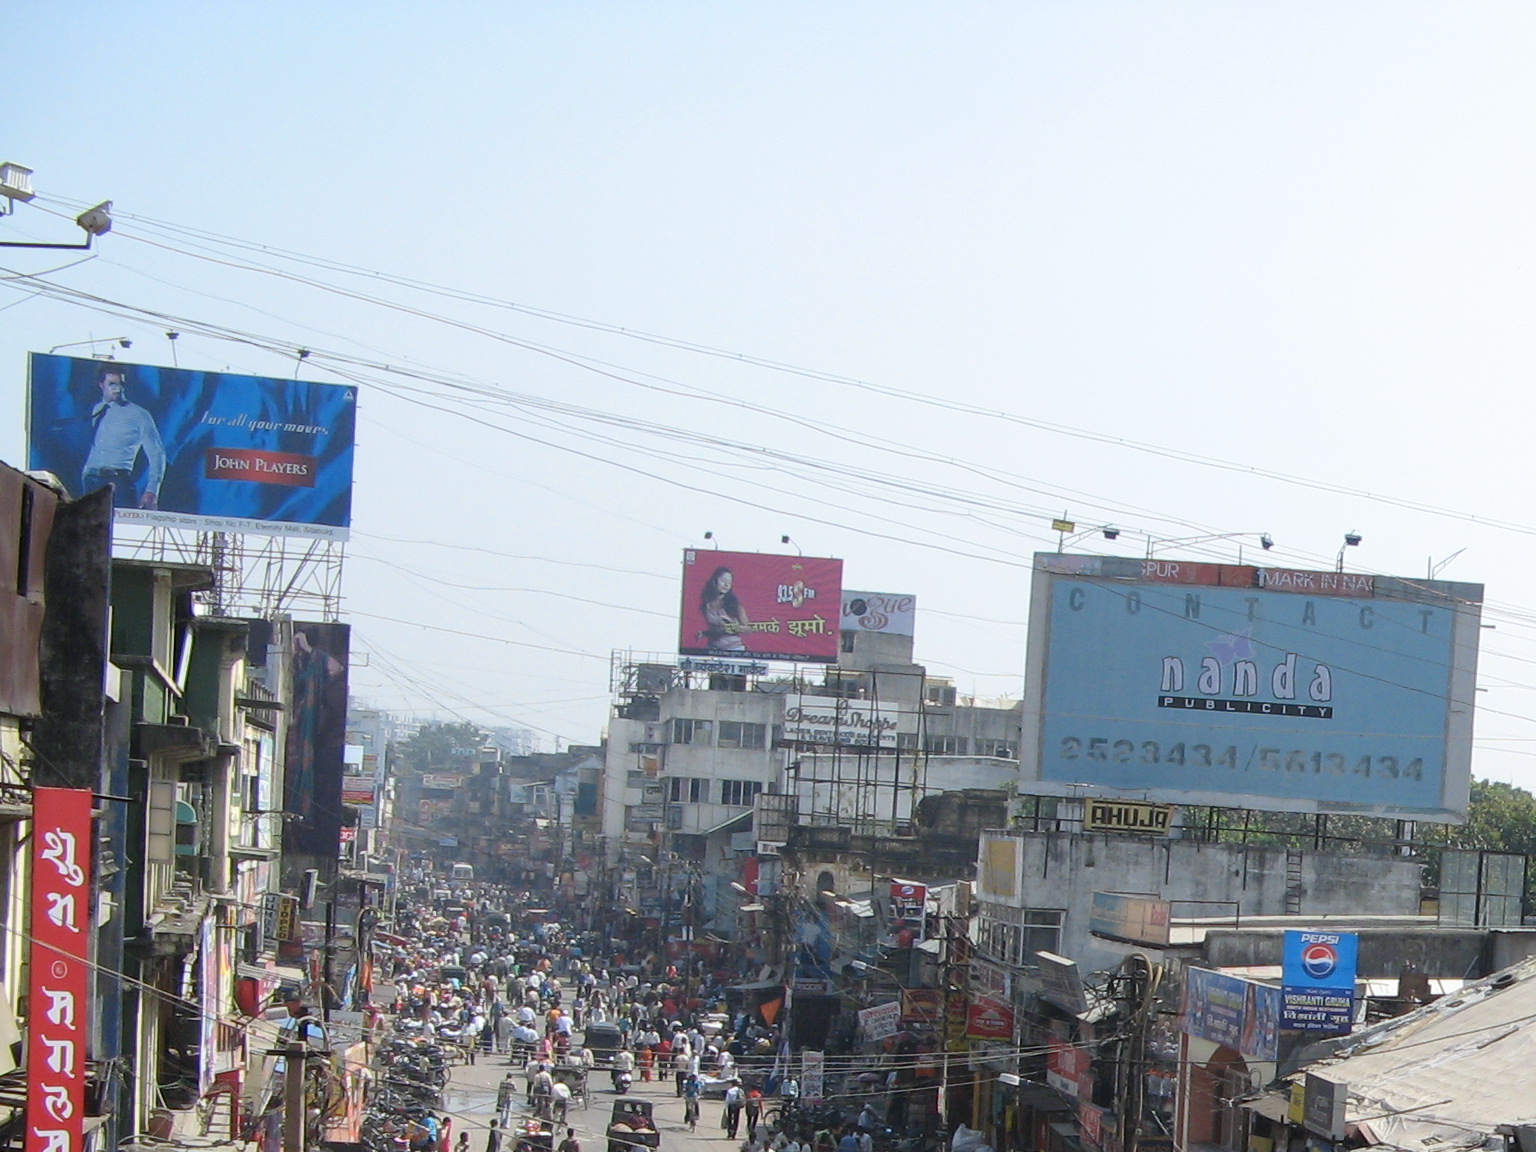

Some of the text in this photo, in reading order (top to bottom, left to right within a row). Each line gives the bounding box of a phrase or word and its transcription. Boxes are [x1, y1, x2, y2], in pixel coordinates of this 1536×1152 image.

[1068, 587, 1435, 635] CONTACT
[1160, 653, 1333, 702] nanda
[1163, 697, 1329, 718] PUBLICITY
[1091, 801, 1168, 830] AHUJA
[1301, 933, 1340, 945] PEPSI
